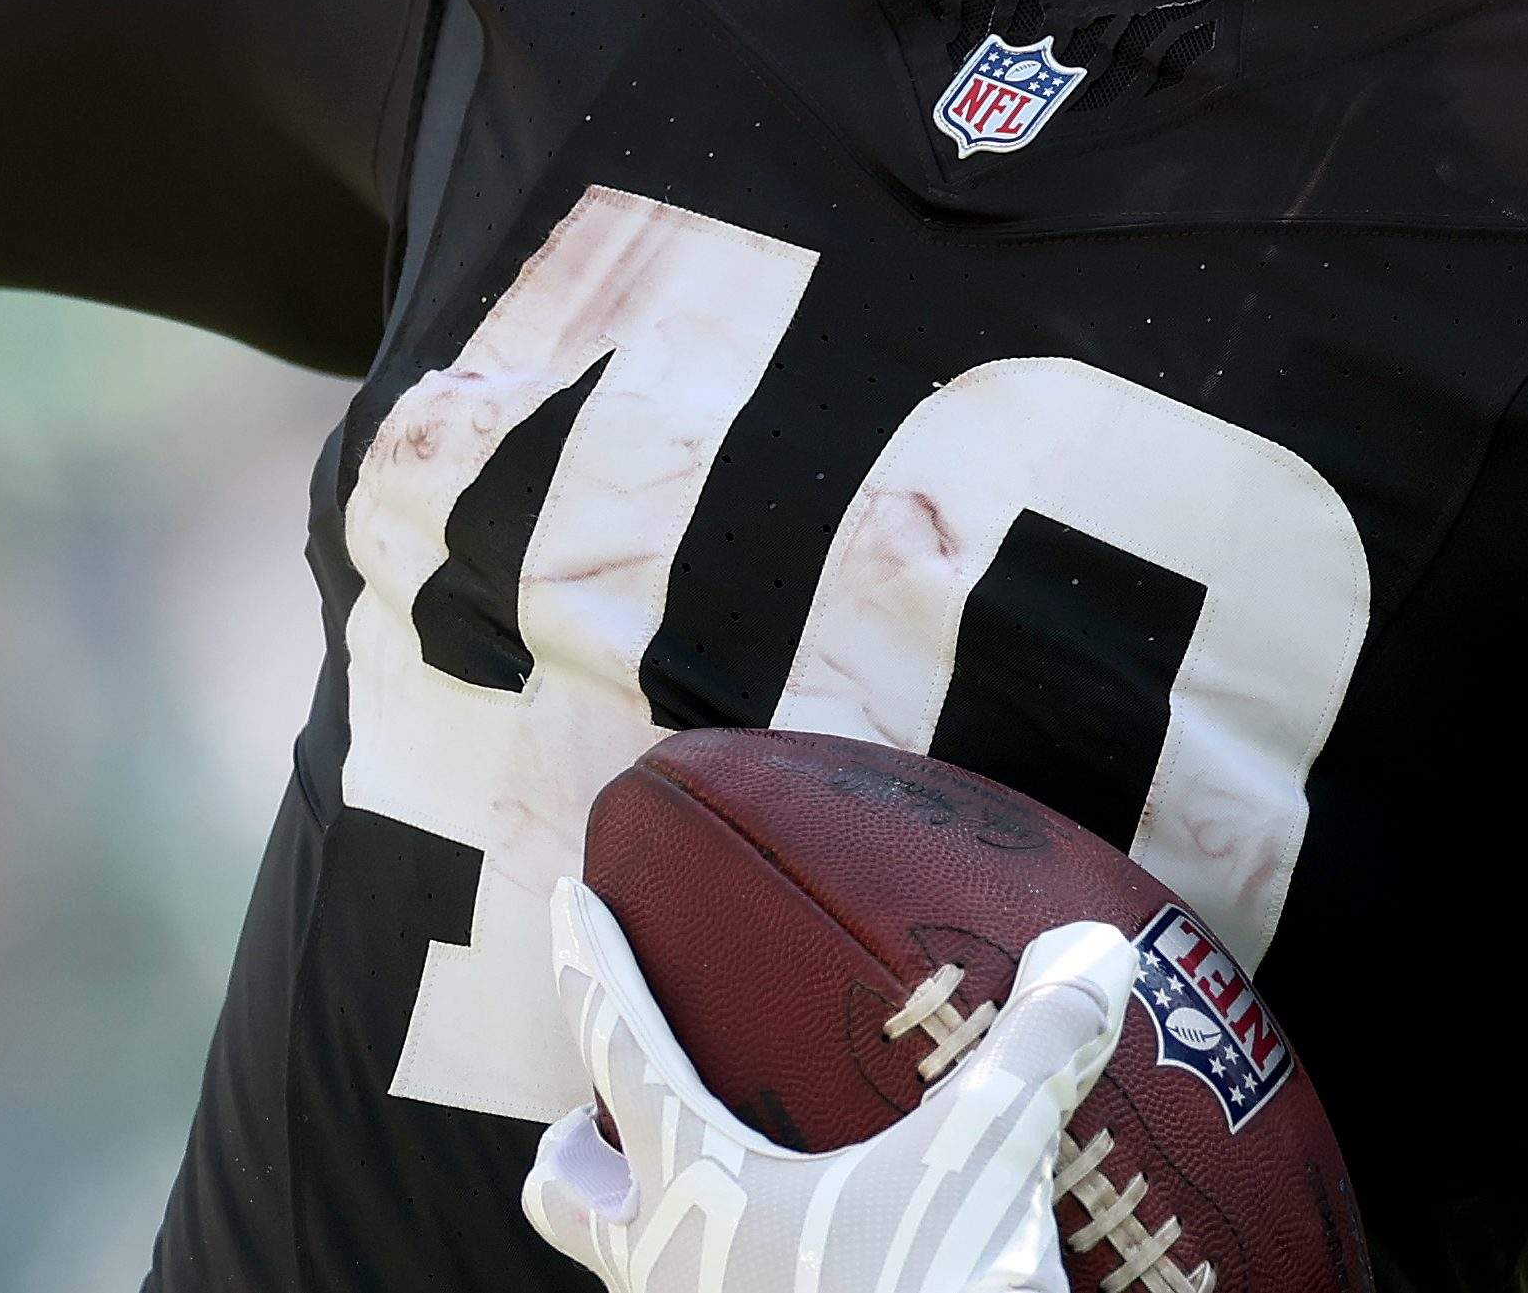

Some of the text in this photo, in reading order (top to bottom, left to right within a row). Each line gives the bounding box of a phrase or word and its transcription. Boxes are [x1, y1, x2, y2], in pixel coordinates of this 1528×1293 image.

[952, 77, 1033, 135] NFL
[343, 183, 1372, 1124] 40
[1176, 919, 1280, 1072] NFL
